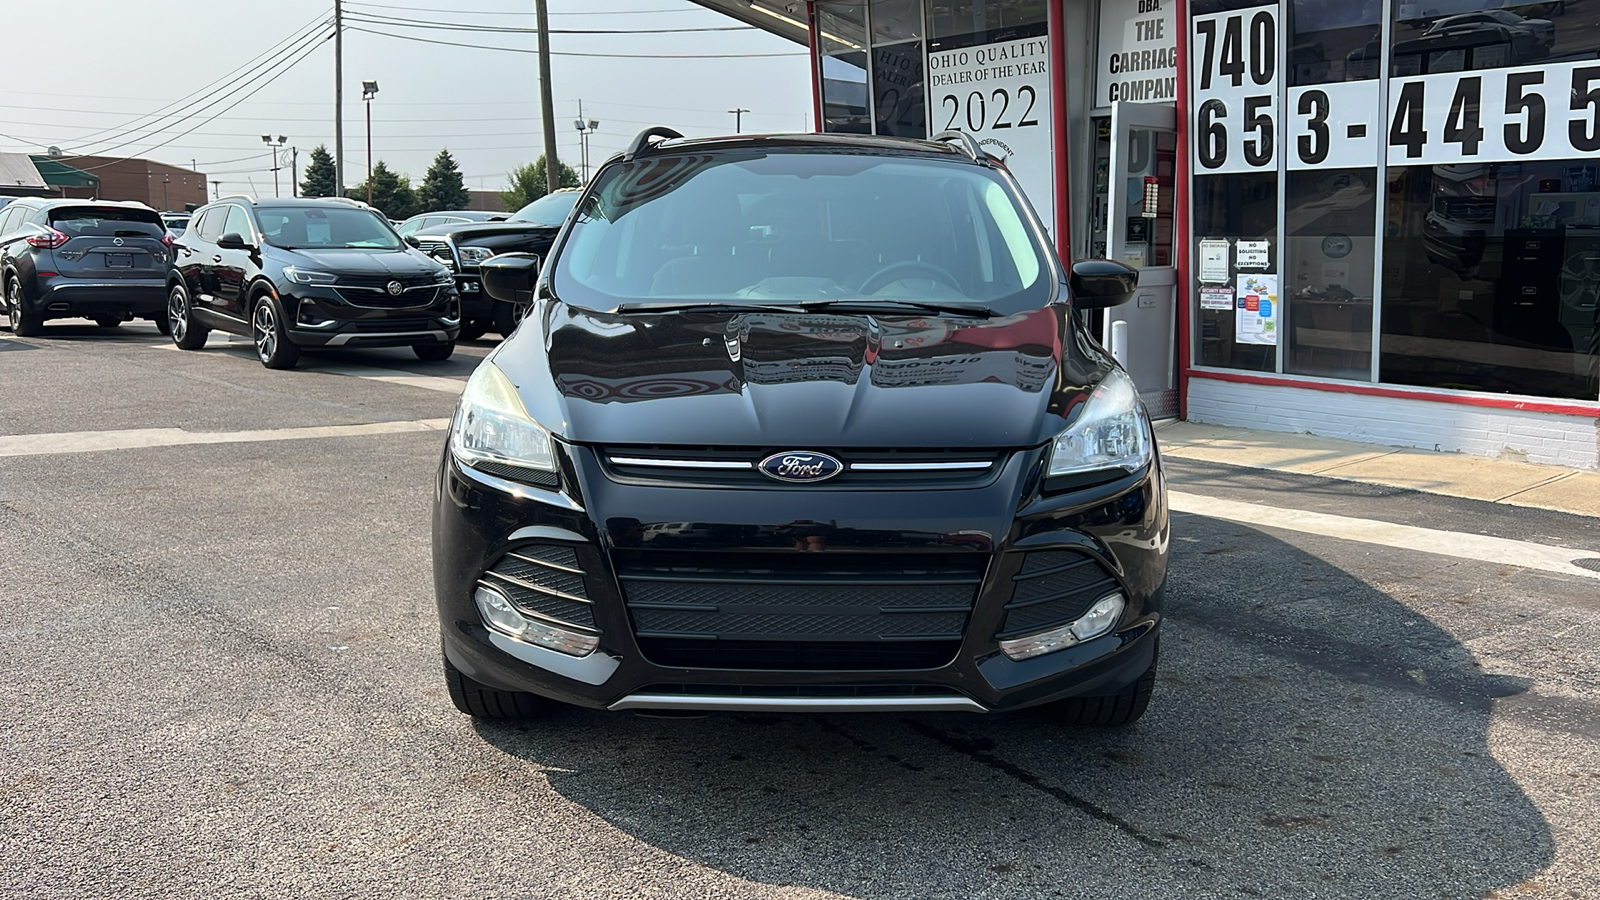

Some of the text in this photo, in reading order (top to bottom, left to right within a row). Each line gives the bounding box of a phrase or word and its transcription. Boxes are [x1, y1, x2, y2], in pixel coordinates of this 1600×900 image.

[1135, 18, 1164, 42] THE
[930, 40, 1047, 70] OHIO QUALITY
[1110, 47, 1177, 74] CARRIAG
[1197, 11, 1275, 90] 740
[932, 60, 1046, 87] DEALER OF THE YEAR
[1109, 77, 1177, 103] COMPAN
[942, 85, 1038, 132] 2022
[978, 138, 1015, 157] NDEPENDENT
[778, 456, 824, 475] Ford
